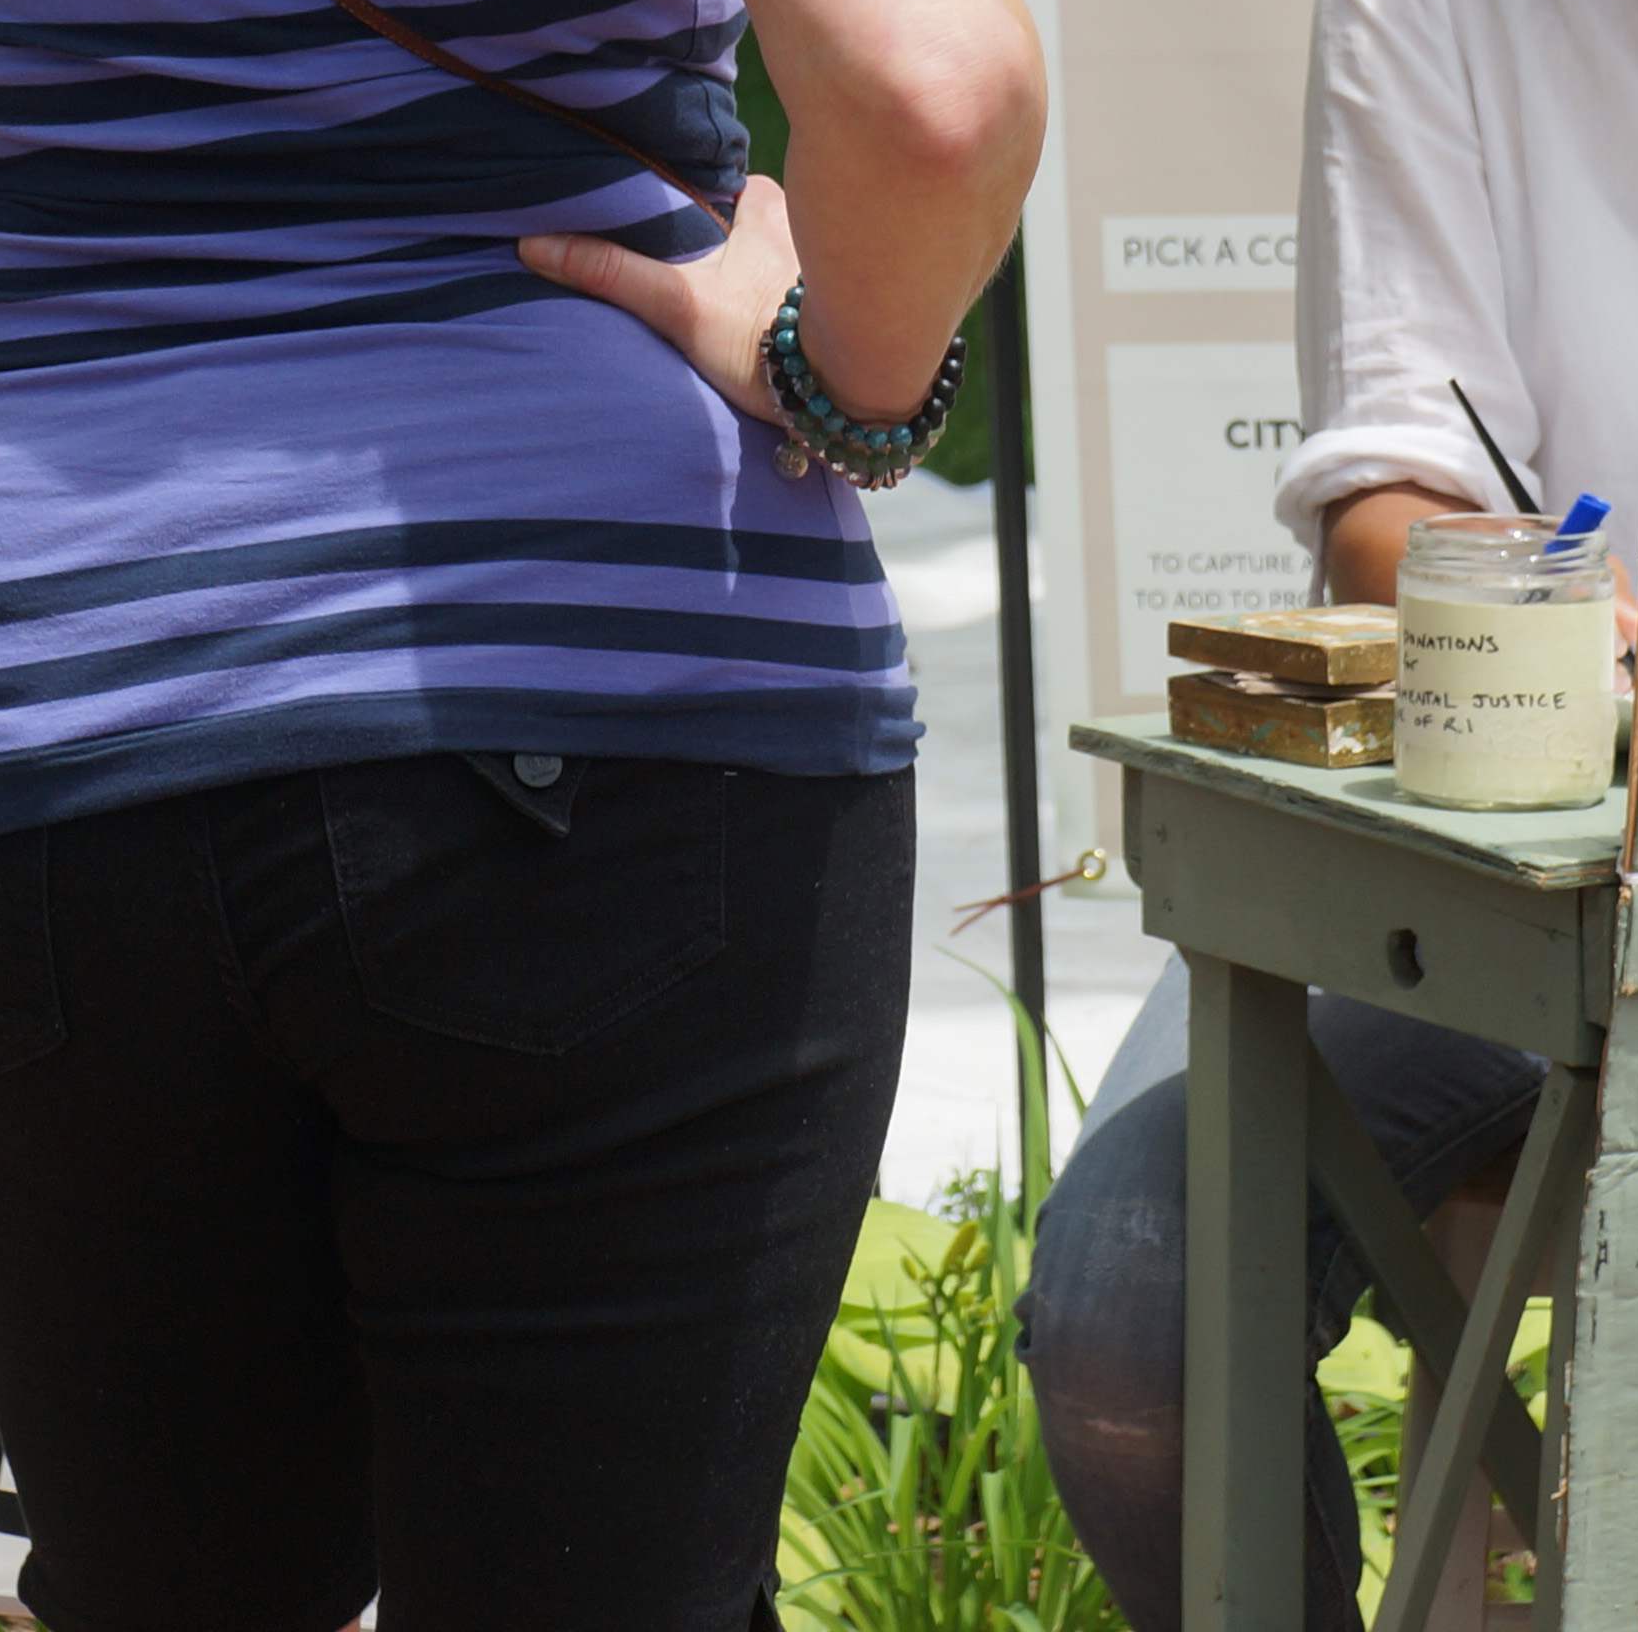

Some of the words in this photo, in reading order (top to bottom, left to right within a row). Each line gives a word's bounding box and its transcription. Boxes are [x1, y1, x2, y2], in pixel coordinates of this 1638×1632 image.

[1123, 234, 1204, 267] PICK
[1213, 235, 1237, 265] A
[1472, 690, 1567, 710] JUSTICE
